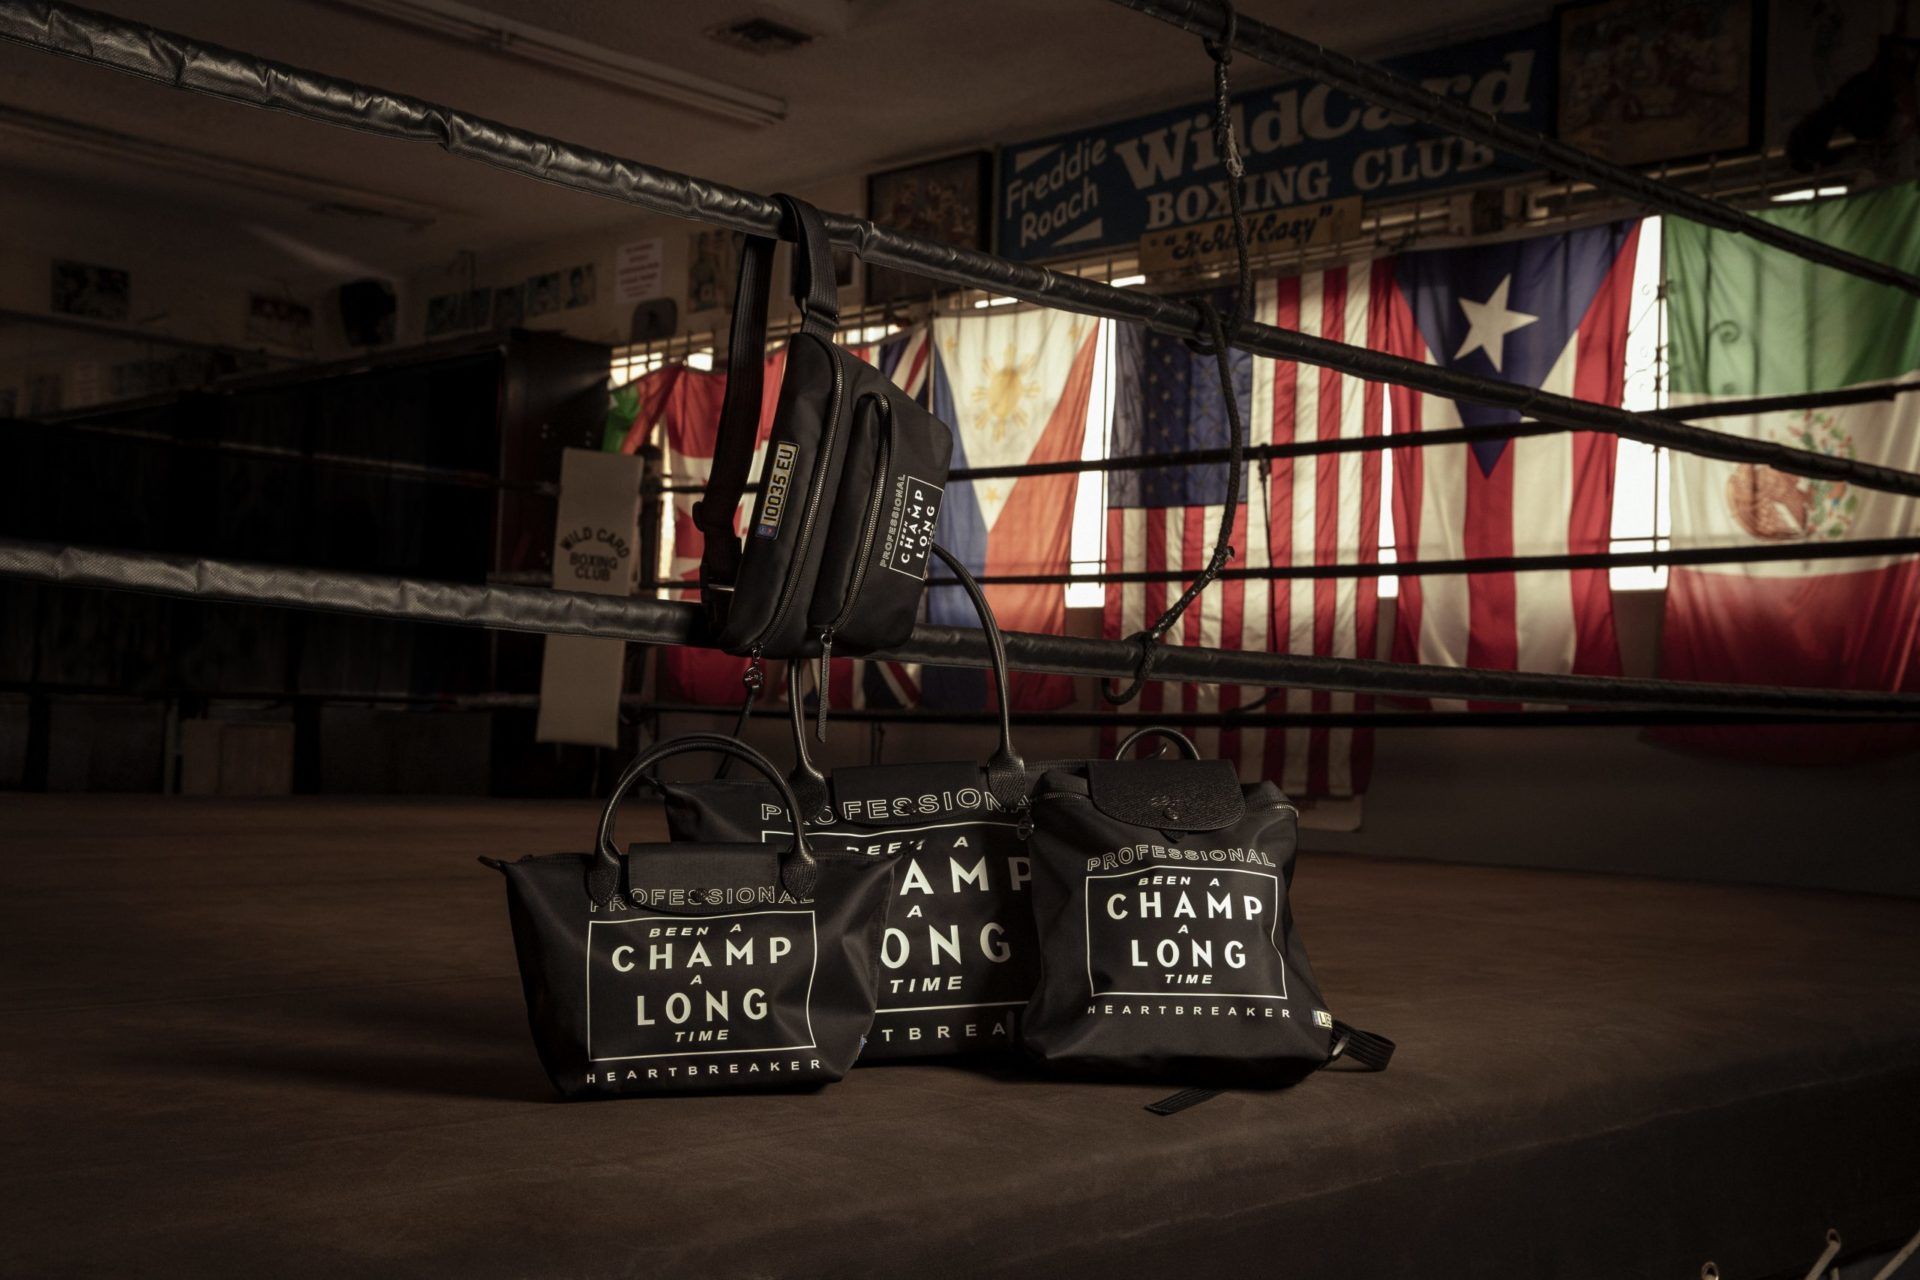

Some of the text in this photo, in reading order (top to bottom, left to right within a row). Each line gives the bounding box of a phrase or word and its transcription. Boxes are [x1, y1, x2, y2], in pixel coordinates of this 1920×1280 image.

[1006, 137, 1108, 220] Freddie
[1145, 134, 1496, 230] BOXING CLUB
[1020, 175, 1099, 249] Roach
[763, 448, 794, 522] 10035 EU
[879, 473, 906, 568] PROFESSIONAL
[900, 489, 924, 564] CHAMP
[915, 505, 936, 560] LONG
[560, 526, 631, 558] WILD CARD
[569, 551, 618, 570] BOXING
[574, 566, 611, 582] CLUB
[953, 836, 969, 848] A
[1086, 844, 1276, 872] PROFESSIONAL
[1137, 875, 1221, 887] BEEN A
[906, 904, 923, 918] A
[1106, 890, 1263, 921] CHAMP
[648, 923, 743, 938] BEEN A
[1177, 923, 1190, 934] A
[610, 936, 793, 973] CHAMP
[1130, 938, 1247, 969] LONG
[689, 974, 703, 986] A
[889, 975, 964, 994] TIME
[1164, 973, 1214, 985] TIME
[636, 988, 768, 1026] LONG
[1087, 1004, 1292, 1020] HEARTBREAKER
[674, 1028, 730, 1043] TIME
[585, 1058, 822, 1084] HEARTBREAKER
